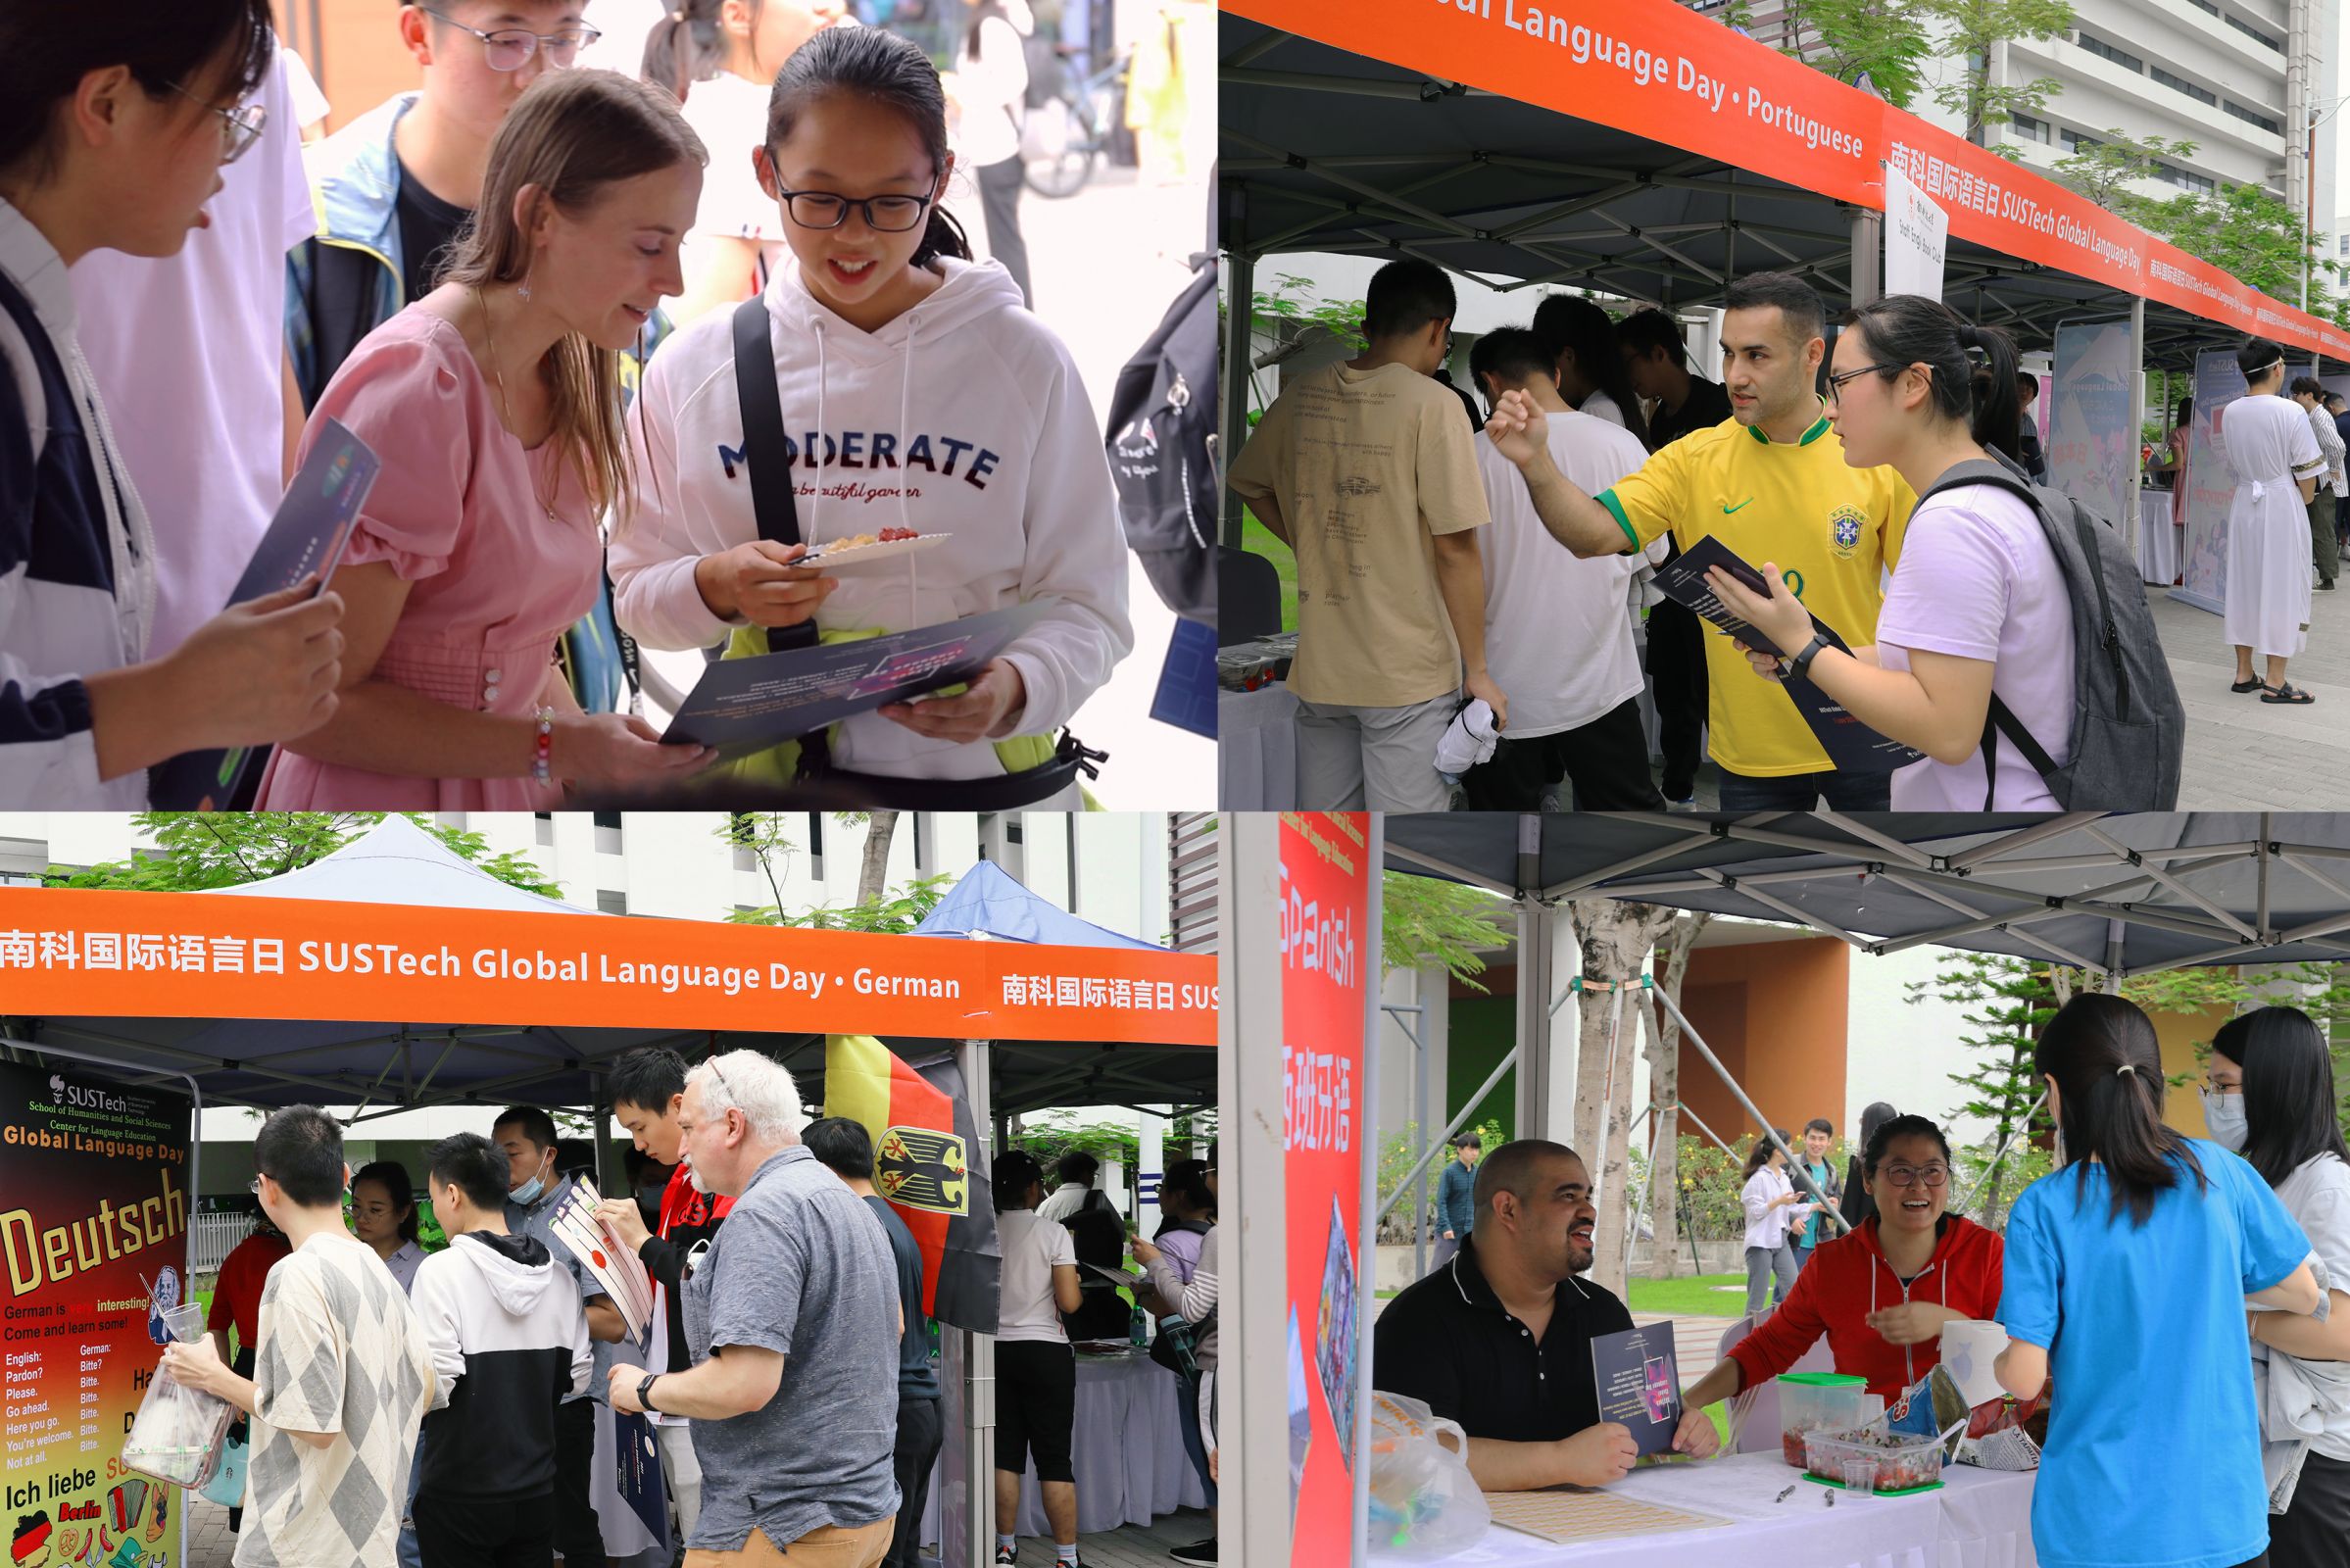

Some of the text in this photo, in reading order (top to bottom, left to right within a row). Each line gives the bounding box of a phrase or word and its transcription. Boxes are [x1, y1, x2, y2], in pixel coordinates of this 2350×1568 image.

[1504, 0, 1863, 159] Language Day Portuguese
[1890, 141, 2000, 218] 南科国际语言日
[2001, 191, 2141, 276] SUSTech Global Language Day
[0, 929, 285, 975] 南科国际语言日
[299, 942, 960, 999] SUSTech Global Language Day German
[1002, 973, 1175, 1011] 南科国际语言日
[68, 1085, 126, 1113] SUSTech
[29, 1101, 56, 1114] School
[68, 1106, 110, 1122] Humanities
[111, 1114, 123, 1124] and
[124, 1115, 144, 1126] Social
[145, 1118, 171, 1130] Sciences
[50, 1120, 157, 1142] Center for Language Education
[3, 1125, 184, 1164] Global Language Day
[0, 1167, 185, 1298] Deutsch
[5, 1302, 53, 1320] German
[56, 1302, 66, 1316] is
[97, 1296, 150, 1312] interesting!
[4, 1316, 128, 1342] Come and learn some!
[6, 1351, 42, 1367] English:
[80, 1344, 112, 1357] German:
[6, 1367, 43, 1383] Pardon?
[80, 1358, 103, 1372] Bitte?
[6, 1388, 38, 1400] Please.
[80, 1377, 100, 1389] Bitte.
[6, 1400, 50, 1418] Go ahead.
[80, 1393, 100, 1404] Bitte.
[80, 1408, 100, 1421] Bitte.
[6, 1417, 60, 1436] Here you go.
[80, 1424, 100, 1437] Bitte.
[37, 1431, 74, 1447] welcome.
[80, 1440, 100, 1452] Bitte.
[6, 1450, 48, 1471] Not at all.
[6, 1479, 41, 1510] Ich
[48, 1468, 96, 1498] liebe
[58, 1498, 102, 1522] Berlin
